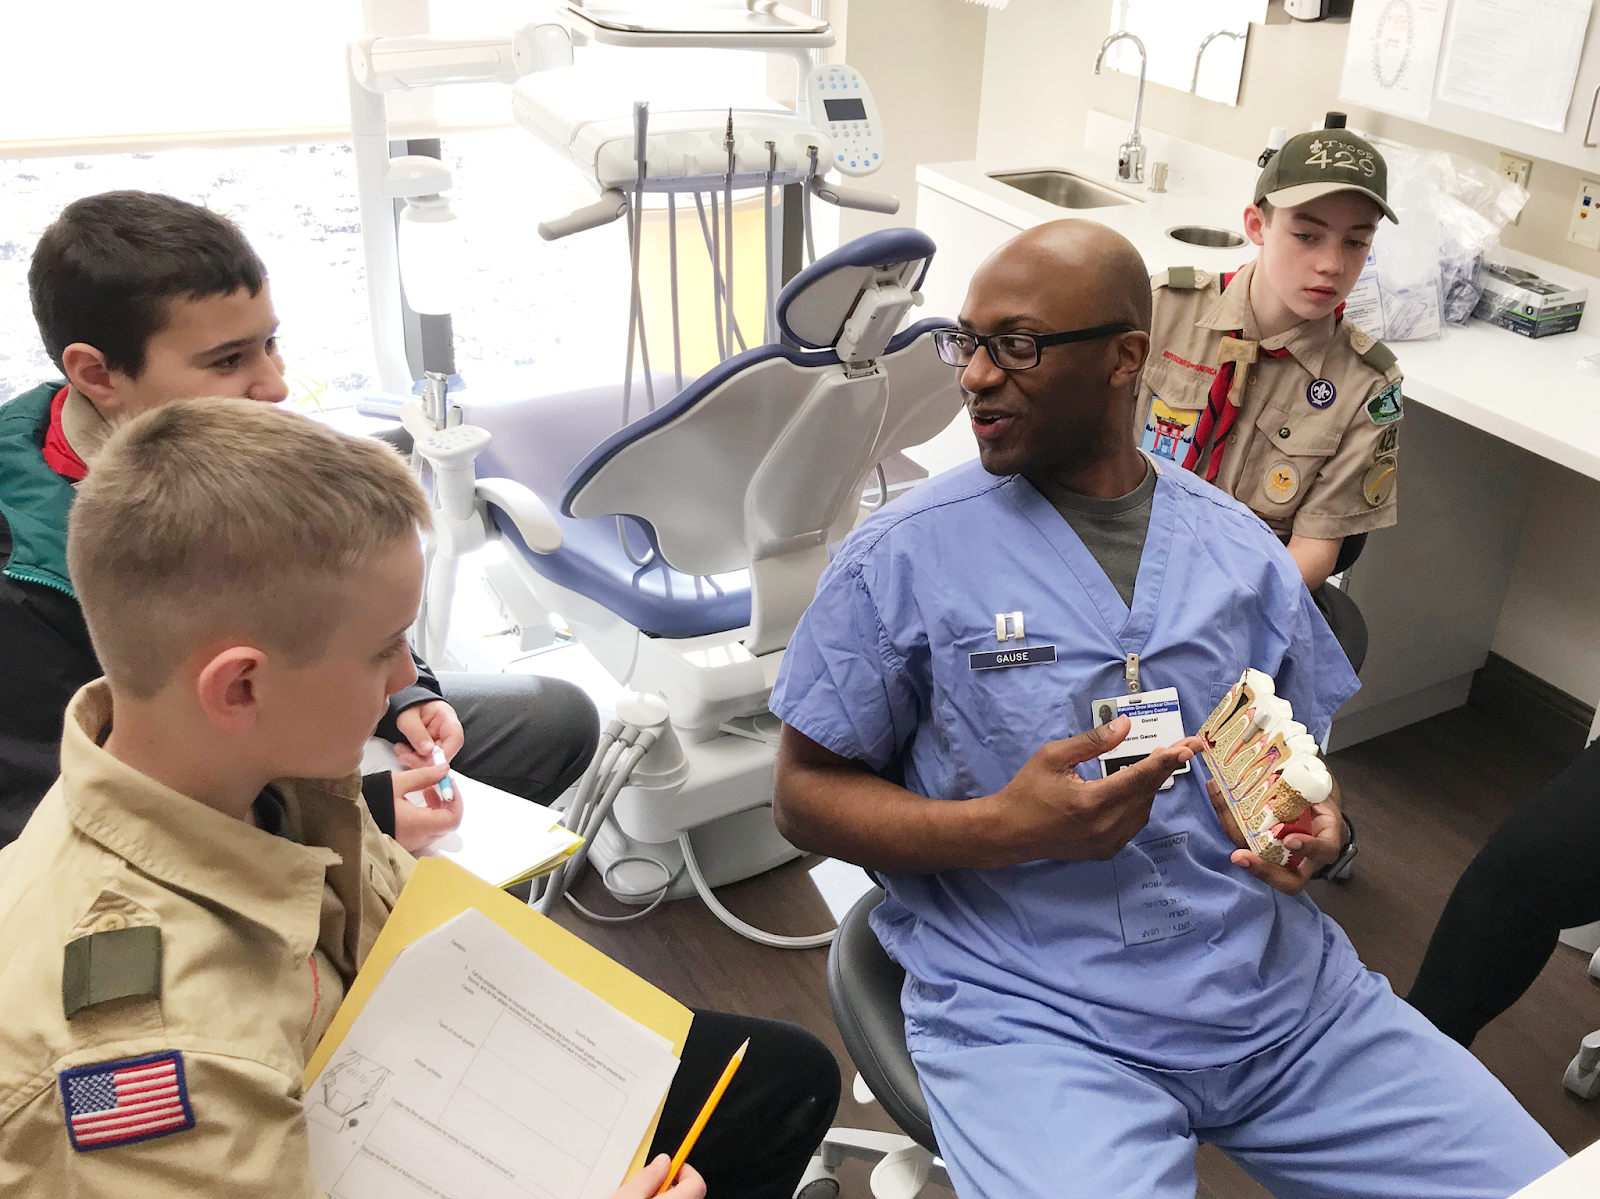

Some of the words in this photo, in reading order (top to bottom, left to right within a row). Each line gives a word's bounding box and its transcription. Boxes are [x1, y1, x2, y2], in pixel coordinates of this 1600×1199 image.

[1323, 139, 1374, 160] Troop
[1305, 149, 1377, 178] 429
[996, 652, 1029, 663] GAUSE
